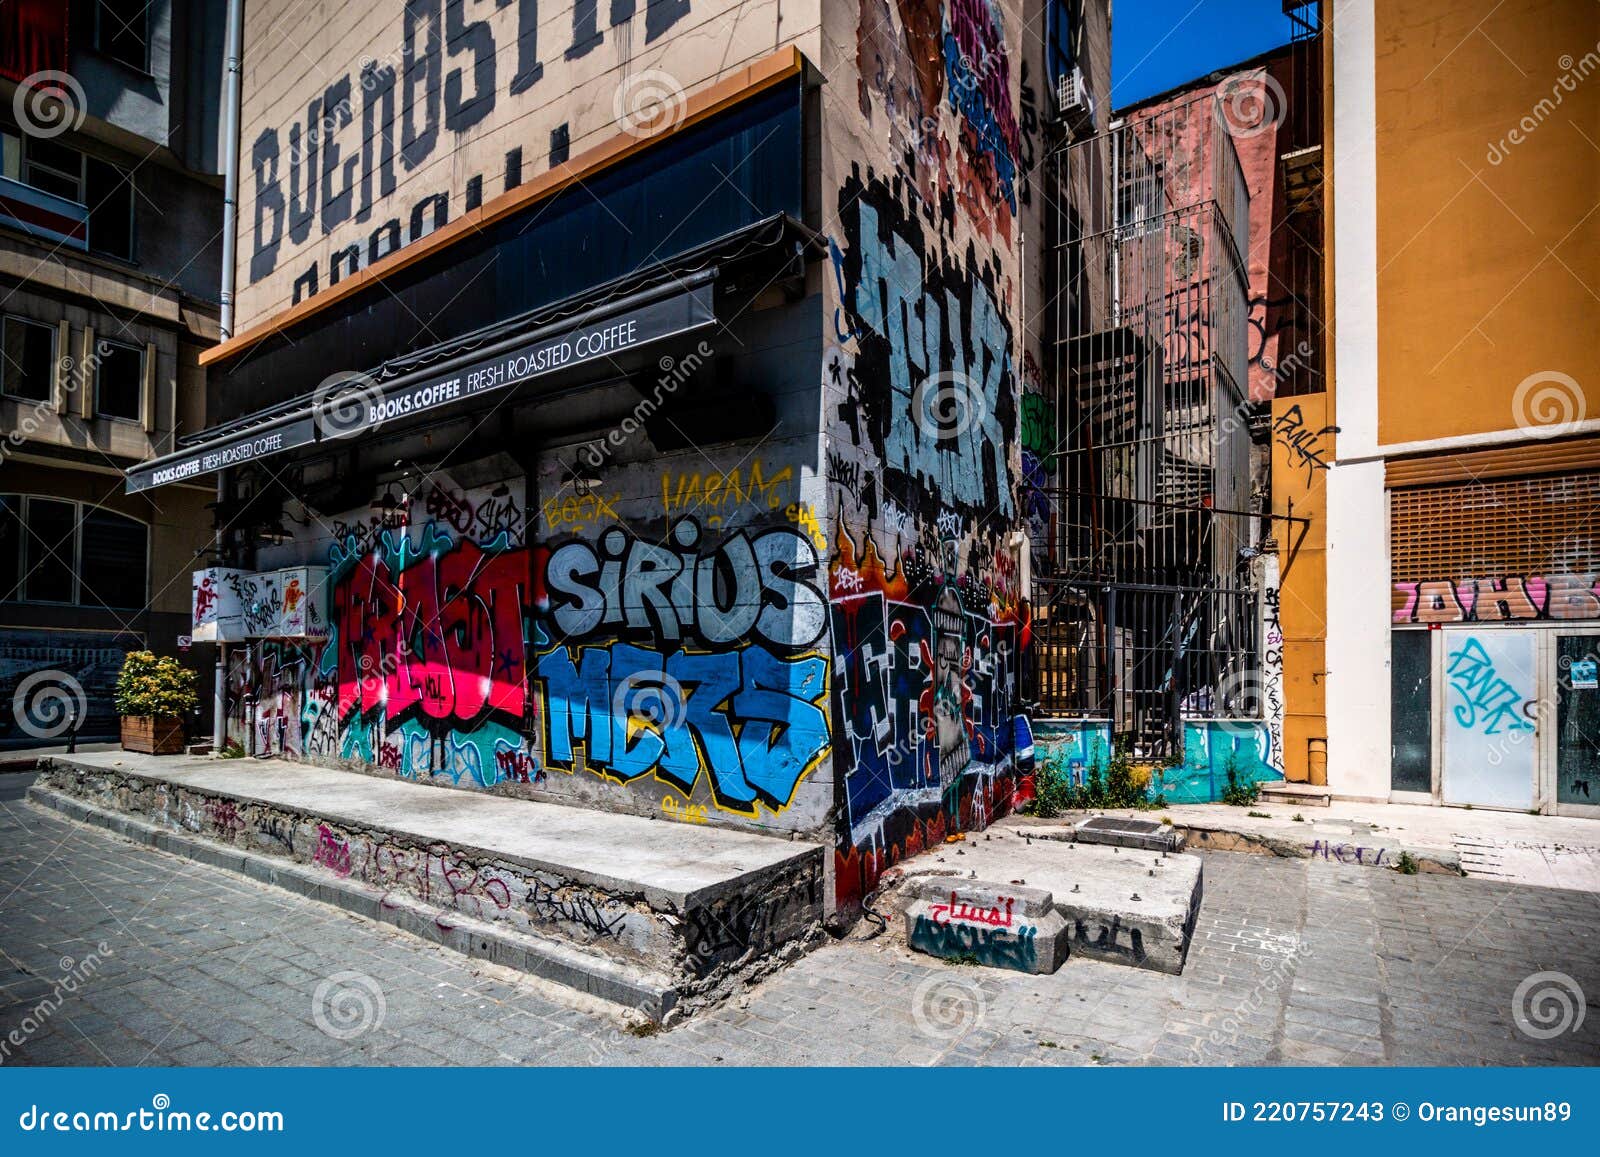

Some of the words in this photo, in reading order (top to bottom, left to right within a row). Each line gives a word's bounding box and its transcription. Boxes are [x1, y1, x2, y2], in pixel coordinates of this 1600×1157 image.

[370, 378, 461, 424] BOOKS.COFFEE
[467, 363, 504, 393] FRESH
[508, 341, 570, 381] ROASTED
[575, 320, 638, 358] COFFEE
[152, 460, 200, 485] BOOKS.COFFEE
[202, 450, 222, 470] FRESH
[222, 439, 253, 465] ROASTED
[254, 433, 283, 455] COFFEE
